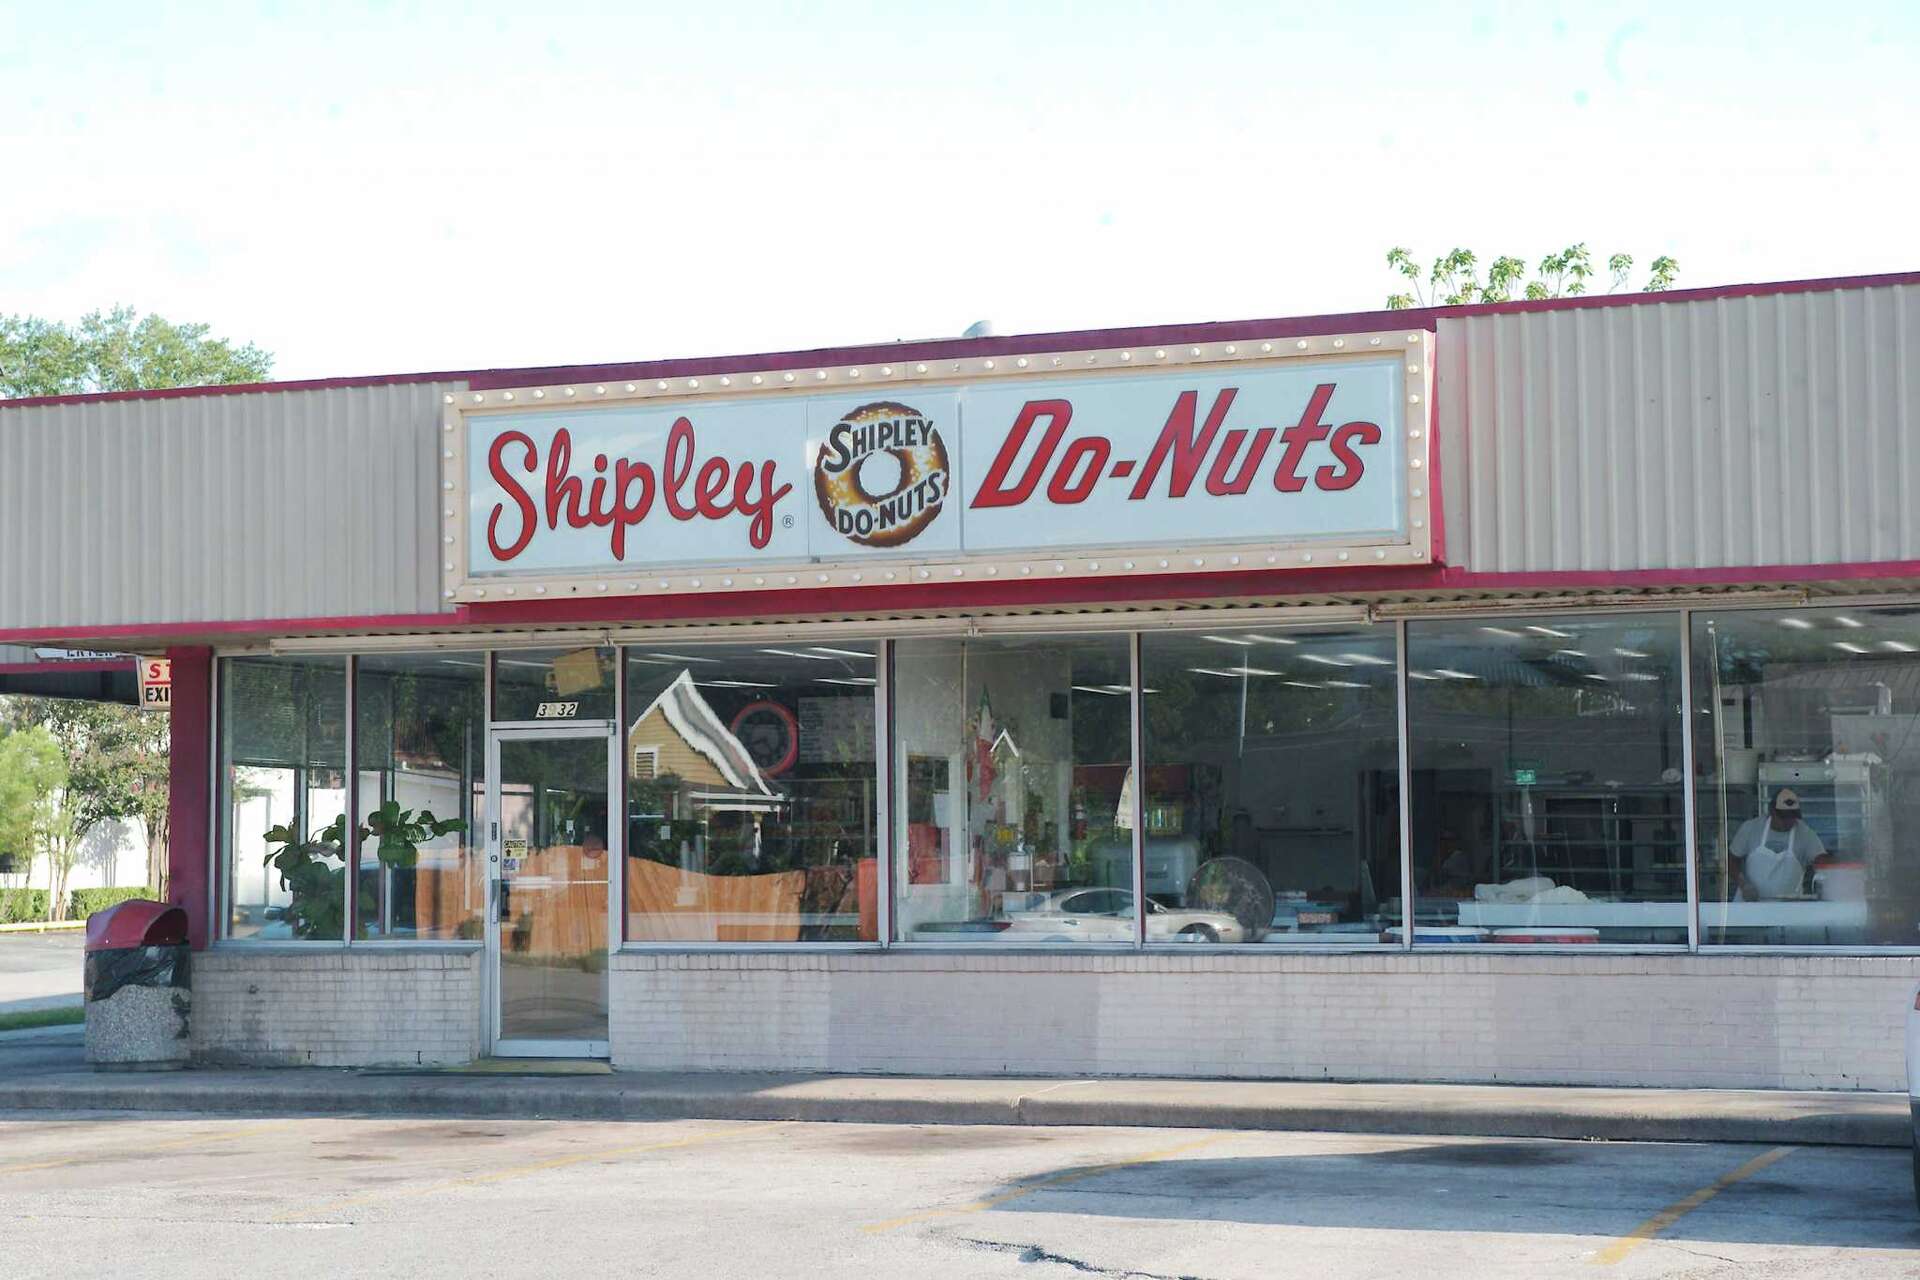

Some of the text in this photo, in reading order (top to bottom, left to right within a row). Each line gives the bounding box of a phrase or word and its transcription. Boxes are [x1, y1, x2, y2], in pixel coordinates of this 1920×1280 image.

[823, 418, 934, 473] SHIPLEY
[970, 383, 1382, 509] Do-Nuts
[487, 416, 793, 561] Shipley
[838, 472, 942, 536] DO-NUTS
[145, 687, 170, 702] EXI
